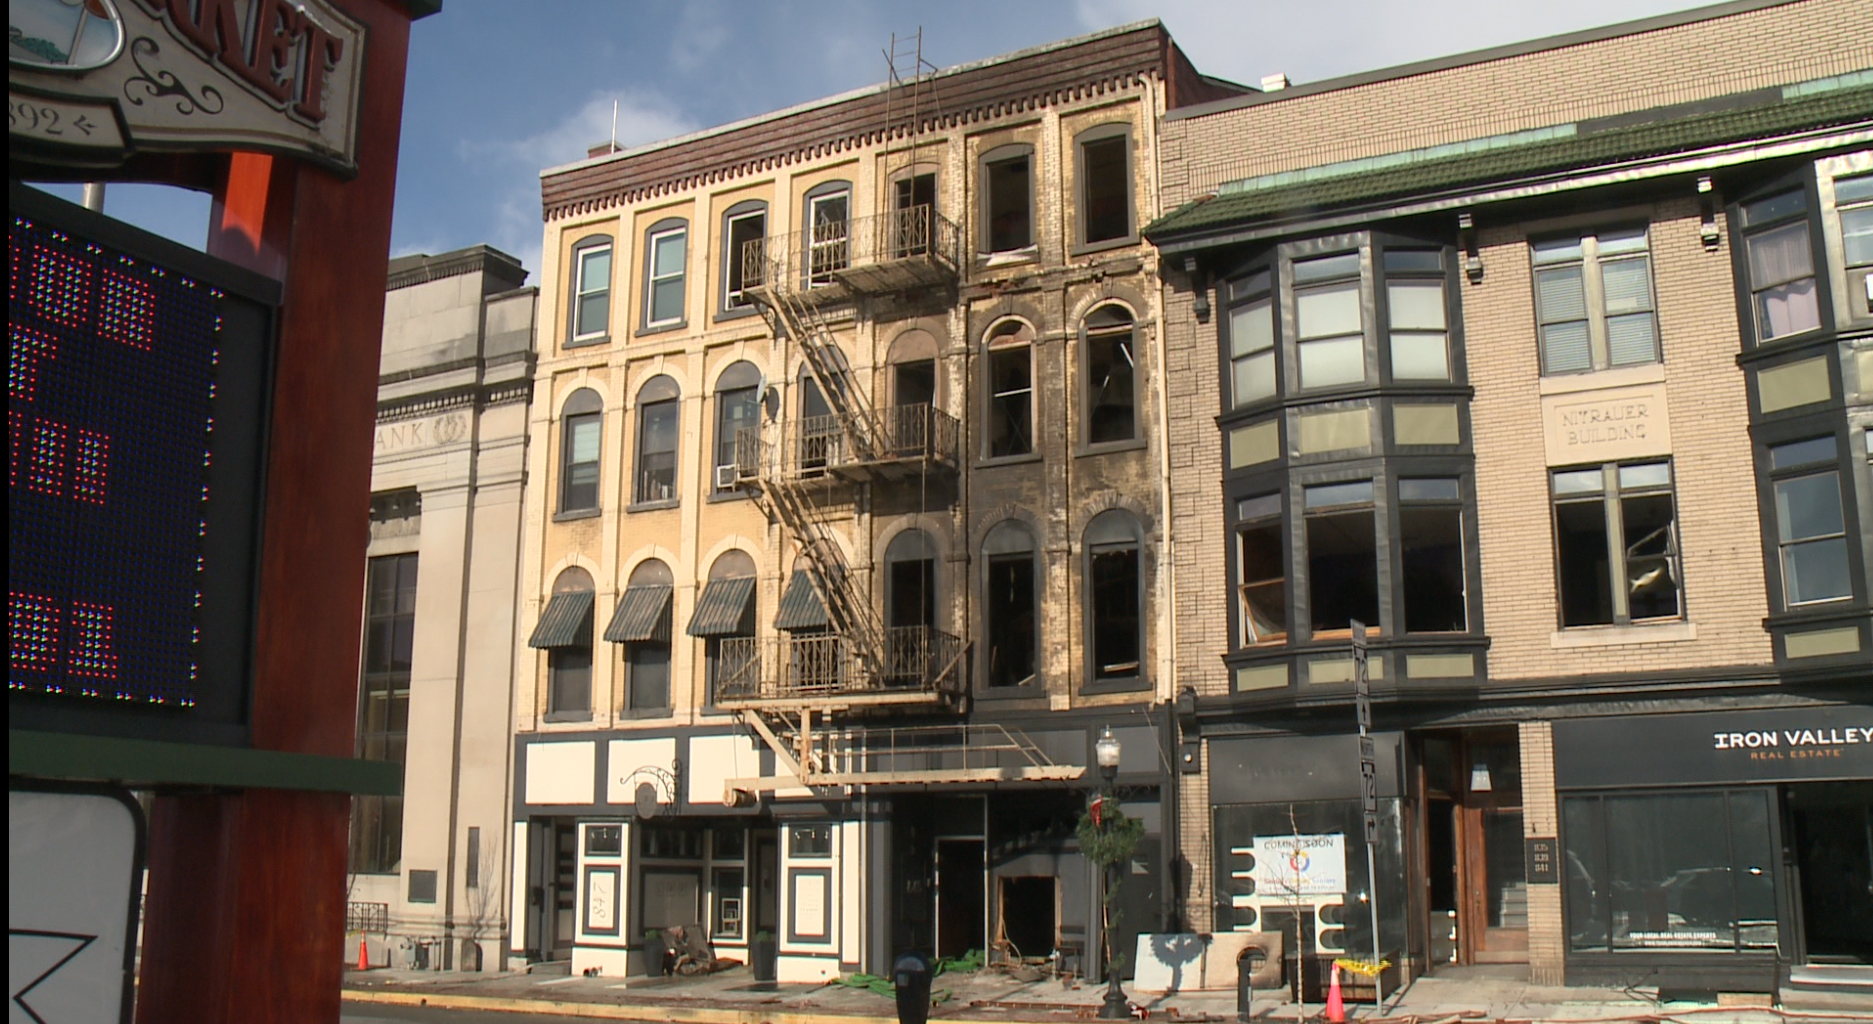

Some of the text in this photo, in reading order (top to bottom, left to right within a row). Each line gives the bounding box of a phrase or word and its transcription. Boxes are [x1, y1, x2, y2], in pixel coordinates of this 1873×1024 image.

[1562, 404, 1649, 426] NITRAUER
[1567, 424, 1647, 446] BUILDING
[1354, 655, 1368, 684] 72
[1714, 728, 1873, 749] IRON VALLEY
[1750, 749, 1841, 760] REAL ESTATE
[1363, 773, 1375, 799] 72
[1305, 838, 1334, 849] SOON
[593, 881, 607, 919] 847
